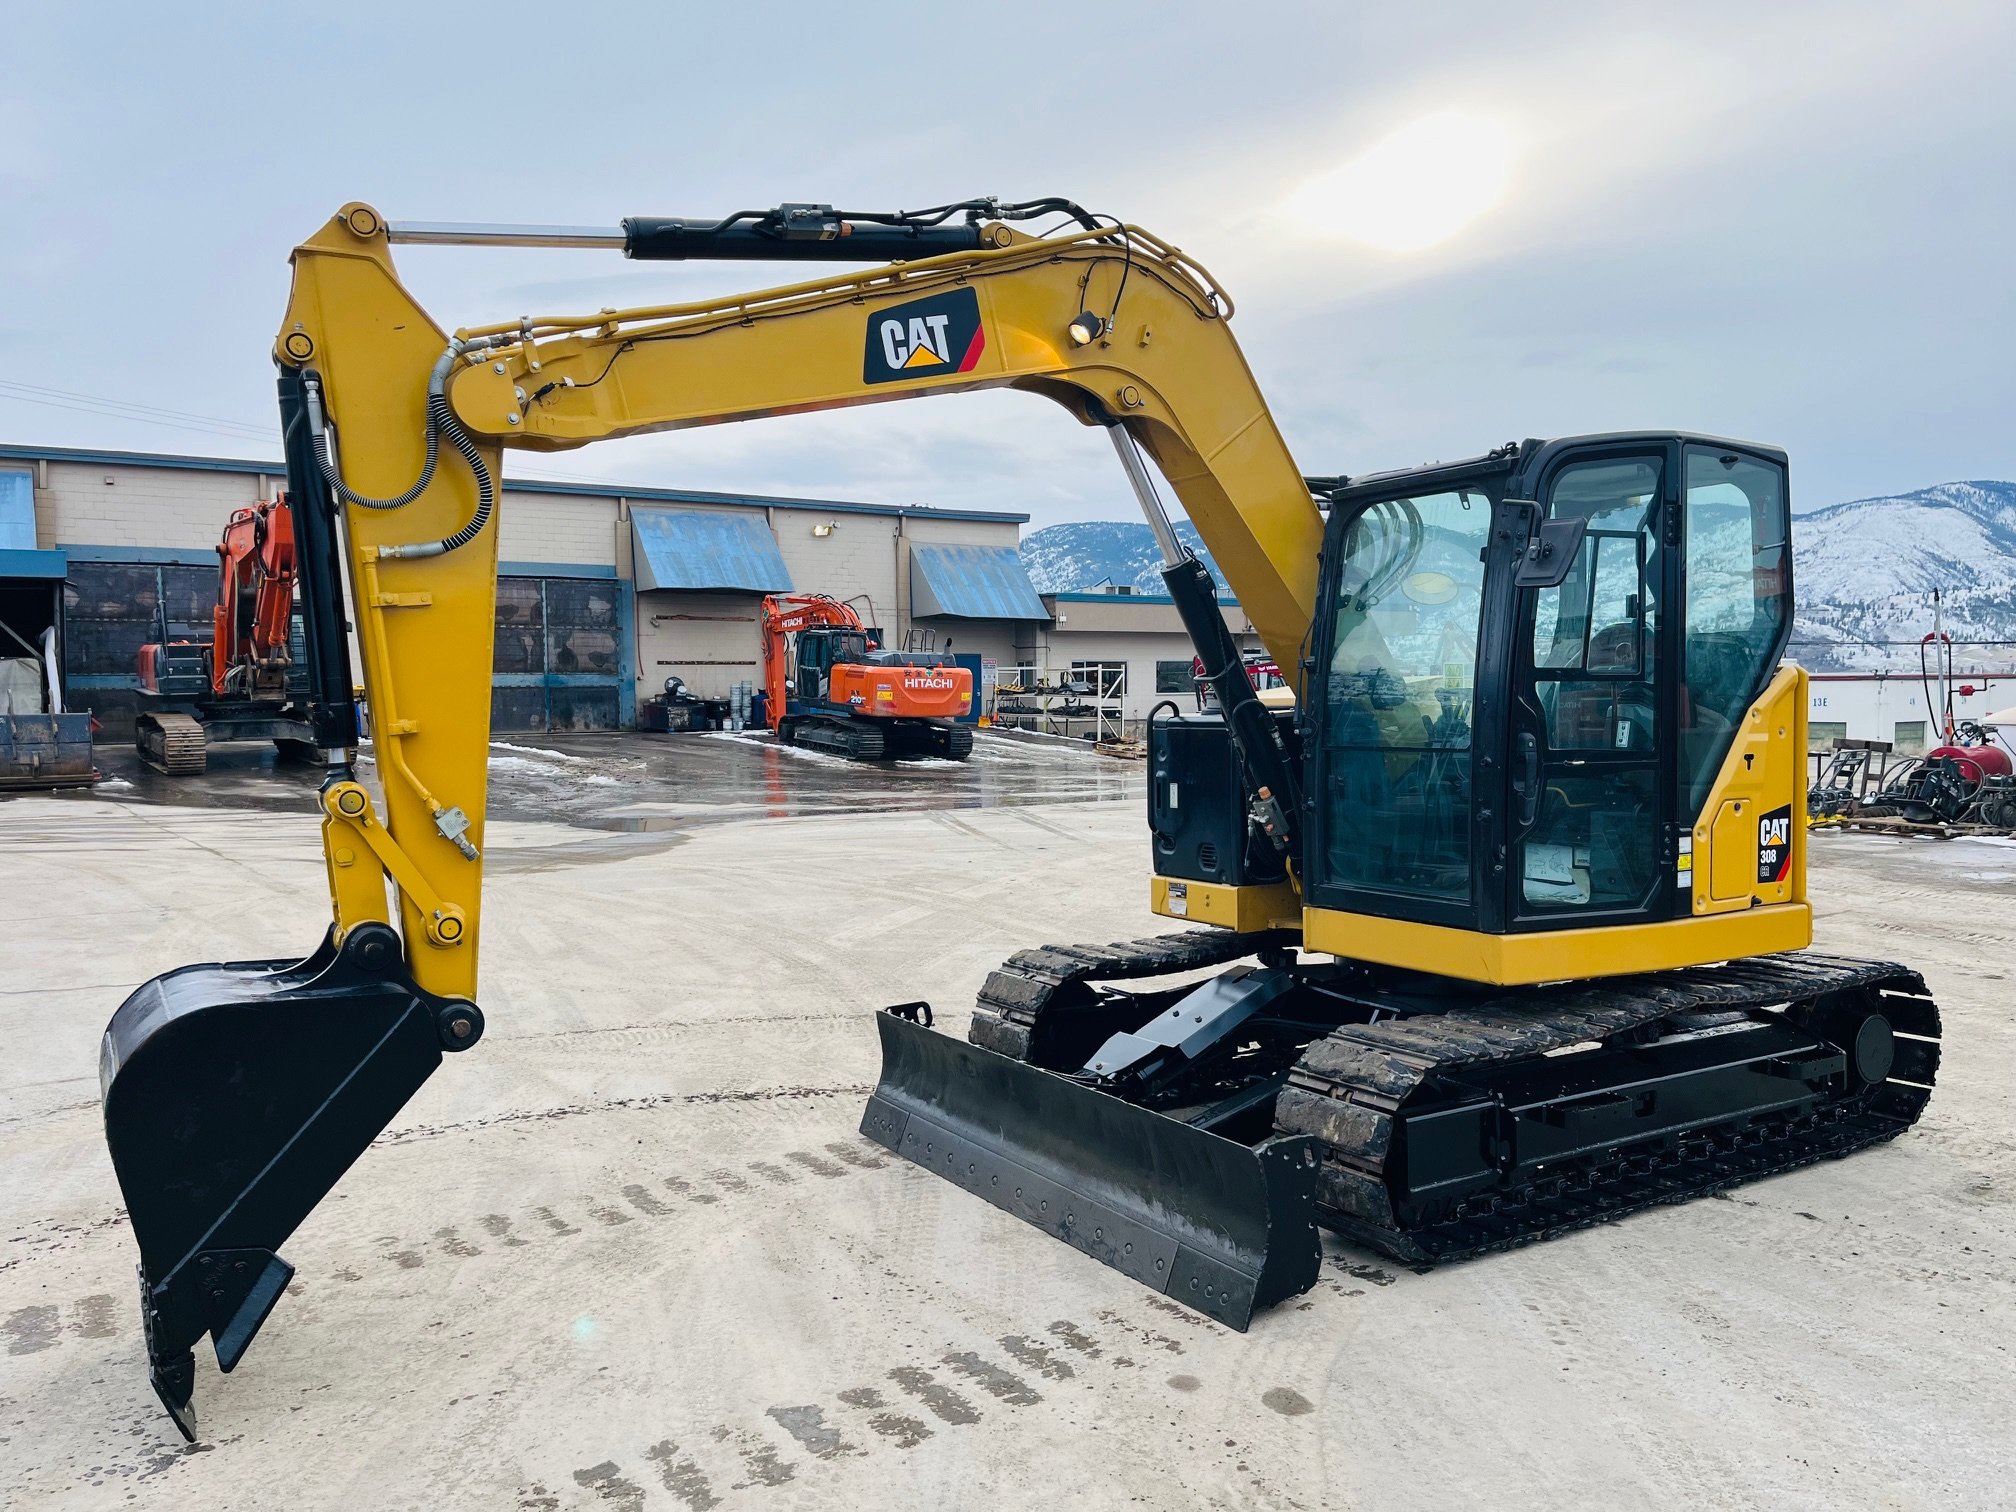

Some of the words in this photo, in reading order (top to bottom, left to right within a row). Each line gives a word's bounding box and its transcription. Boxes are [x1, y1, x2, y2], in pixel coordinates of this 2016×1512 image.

[880, 314, 950, 370] CAT
[781, 617, 803, 628] HITACHI
[904, 678, 953, 689] HITACHI
[850, 695, 862, 704] 210
[1813, 697, 1828, 707] 13E
[1760, 818, 1789, 847] CAT
[1760, 849, 1777, 864] 308
